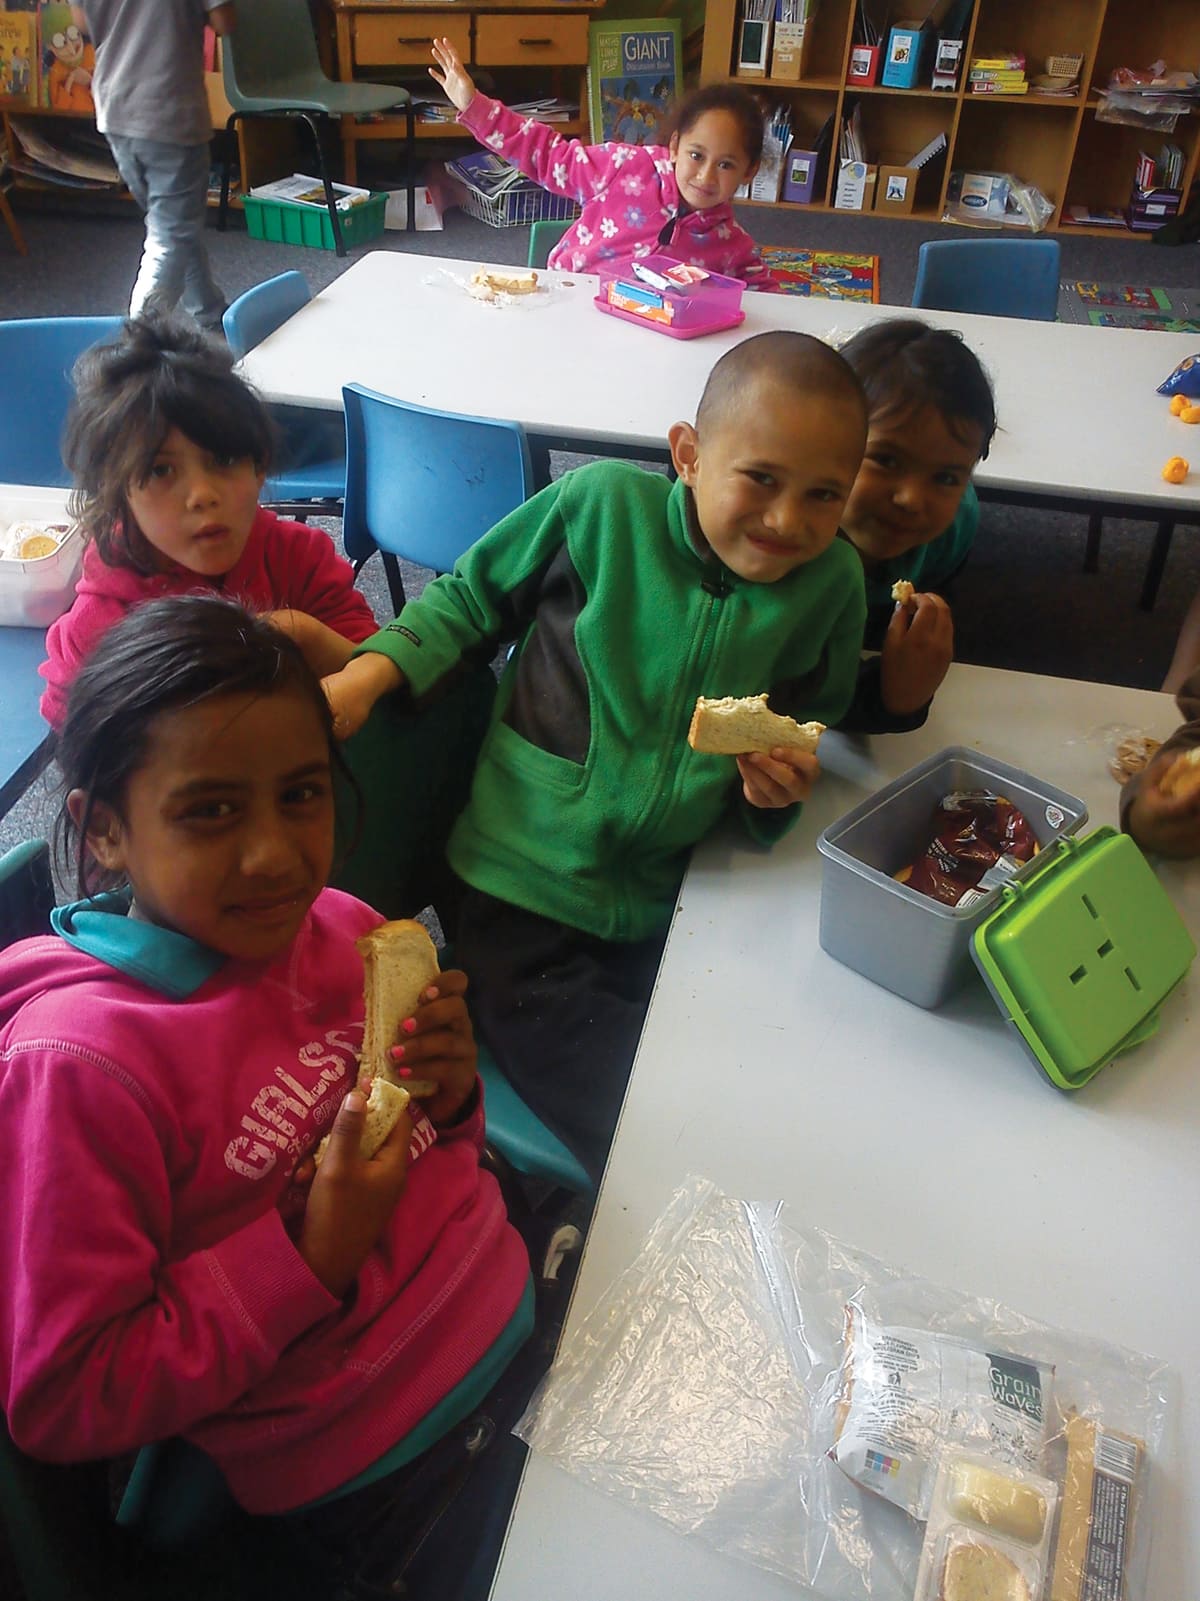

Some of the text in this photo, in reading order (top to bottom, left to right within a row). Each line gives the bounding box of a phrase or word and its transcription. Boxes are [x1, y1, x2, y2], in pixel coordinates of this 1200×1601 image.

[624, 36, 670, 61] GIANT
[224, 1041, 346, 1181] GIRLS
[990, 1367, 1041, 1399] Grain
